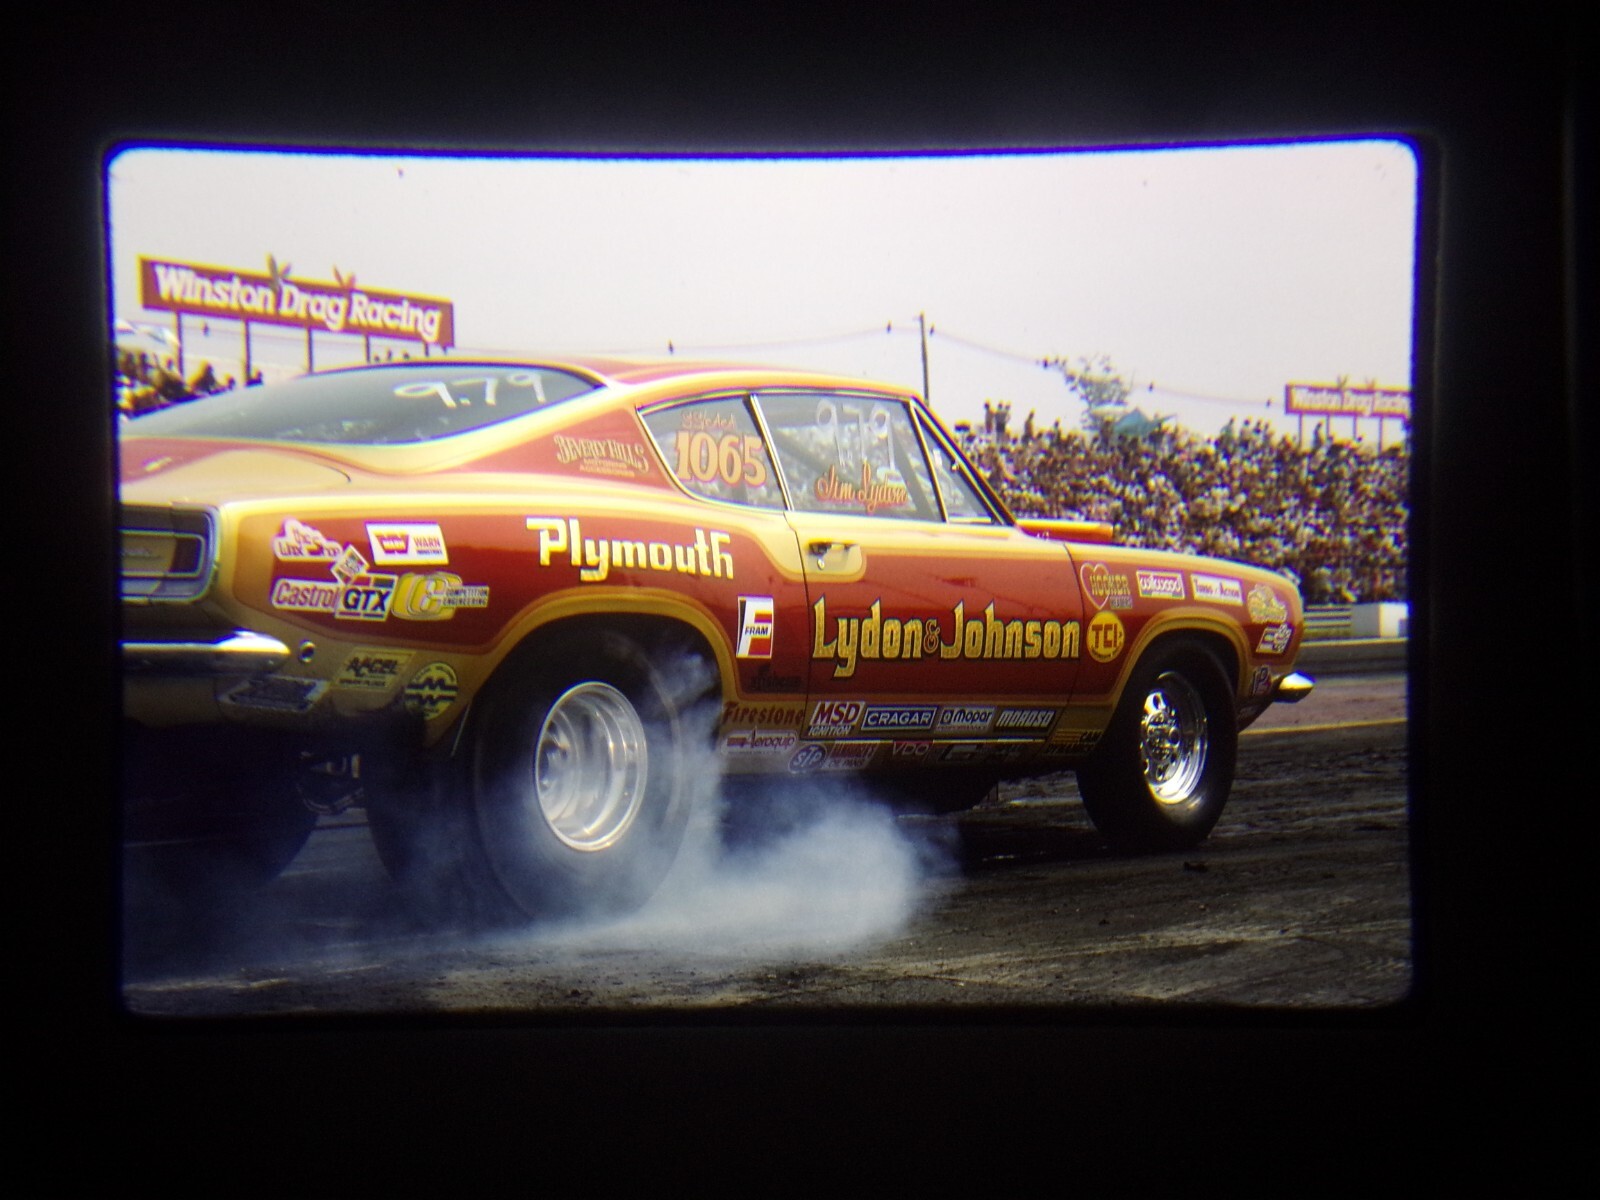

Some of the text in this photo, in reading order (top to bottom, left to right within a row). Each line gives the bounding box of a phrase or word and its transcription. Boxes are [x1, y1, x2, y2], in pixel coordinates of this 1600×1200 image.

[154, 262, 441, 342] Winston Drag Racing
[393, 371, 547, 409] 9.79
[553, 433, 649, 474] BEVERLY HILLS
[674, 430, 767, 488] 1065
[815, 463, 857, 503] Jim
[413, 536, 442, 548] WARN
[526, 516, 734, 582] Plymouth
[276, 580, 339, 609] Castrol
[1090, 574, 1131, 596] HOOKER
[343, 588, 392, 613] GTX
[744, 626, 769, 635] FRAM
[812, 594, 1080, 677] Lydon & Johnson
[1091, 623, 1118, 648] TCI
[722, 701, 805, 726] Firestone
[814, 701, 862, 726] MSD
[866, 710, 932, 725] CRAGAR
[953, 709, 993, 724] Mopar
[996, 709, 1056, 727] MOROSO
[748, 727, 796, 748] Aeroquip
[808, 725, 852, 737] IGNITION
[792, 745, 822, 767] STP
[892, 742, 929, 756] VDO
